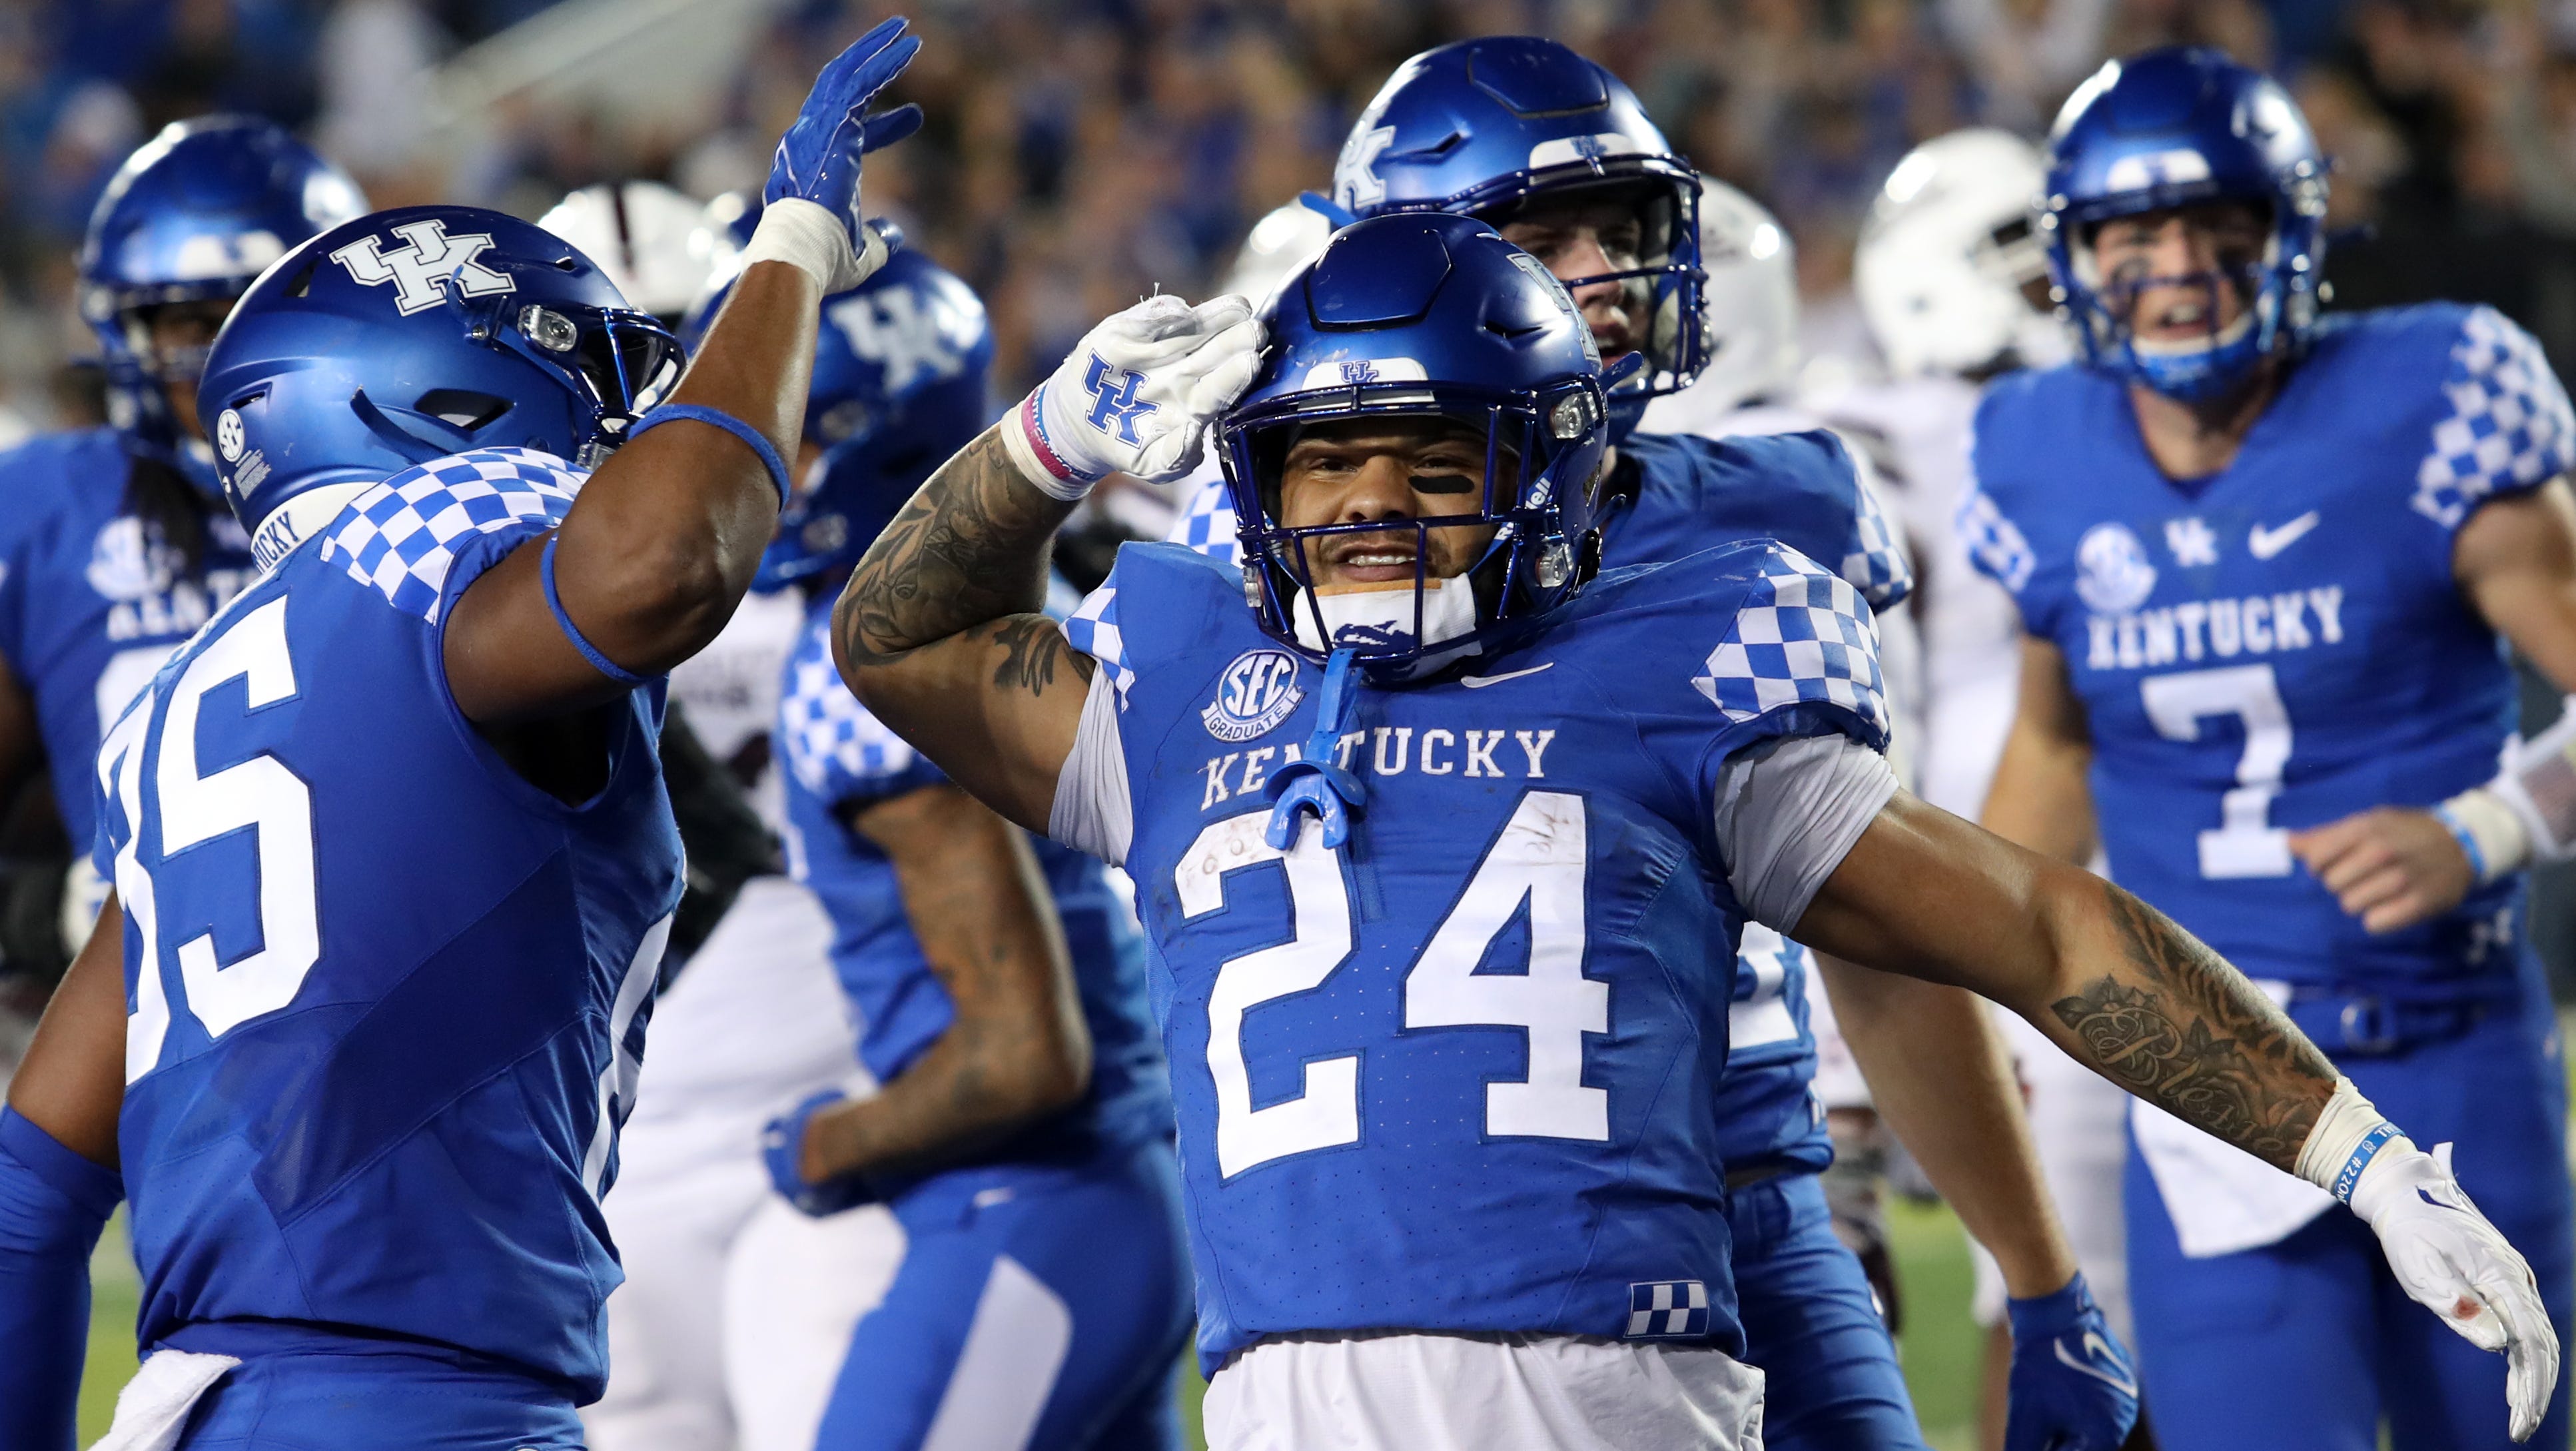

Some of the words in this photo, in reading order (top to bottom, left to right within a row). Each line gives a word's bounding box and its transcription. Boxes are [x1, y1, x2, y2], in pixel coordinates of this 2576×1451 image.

[329, 219, 517, 317] UK
[1082, 348, 1161, 449] UK
[1209, 706, 1287, 740] GRADUATE
[1225, 654, 1292, 716] SEC
[1199, 726, 1556, 812] KETUCKY
[2141, 664, 2293, 879] 7
[1174, 790, 1609, 1181] 24
